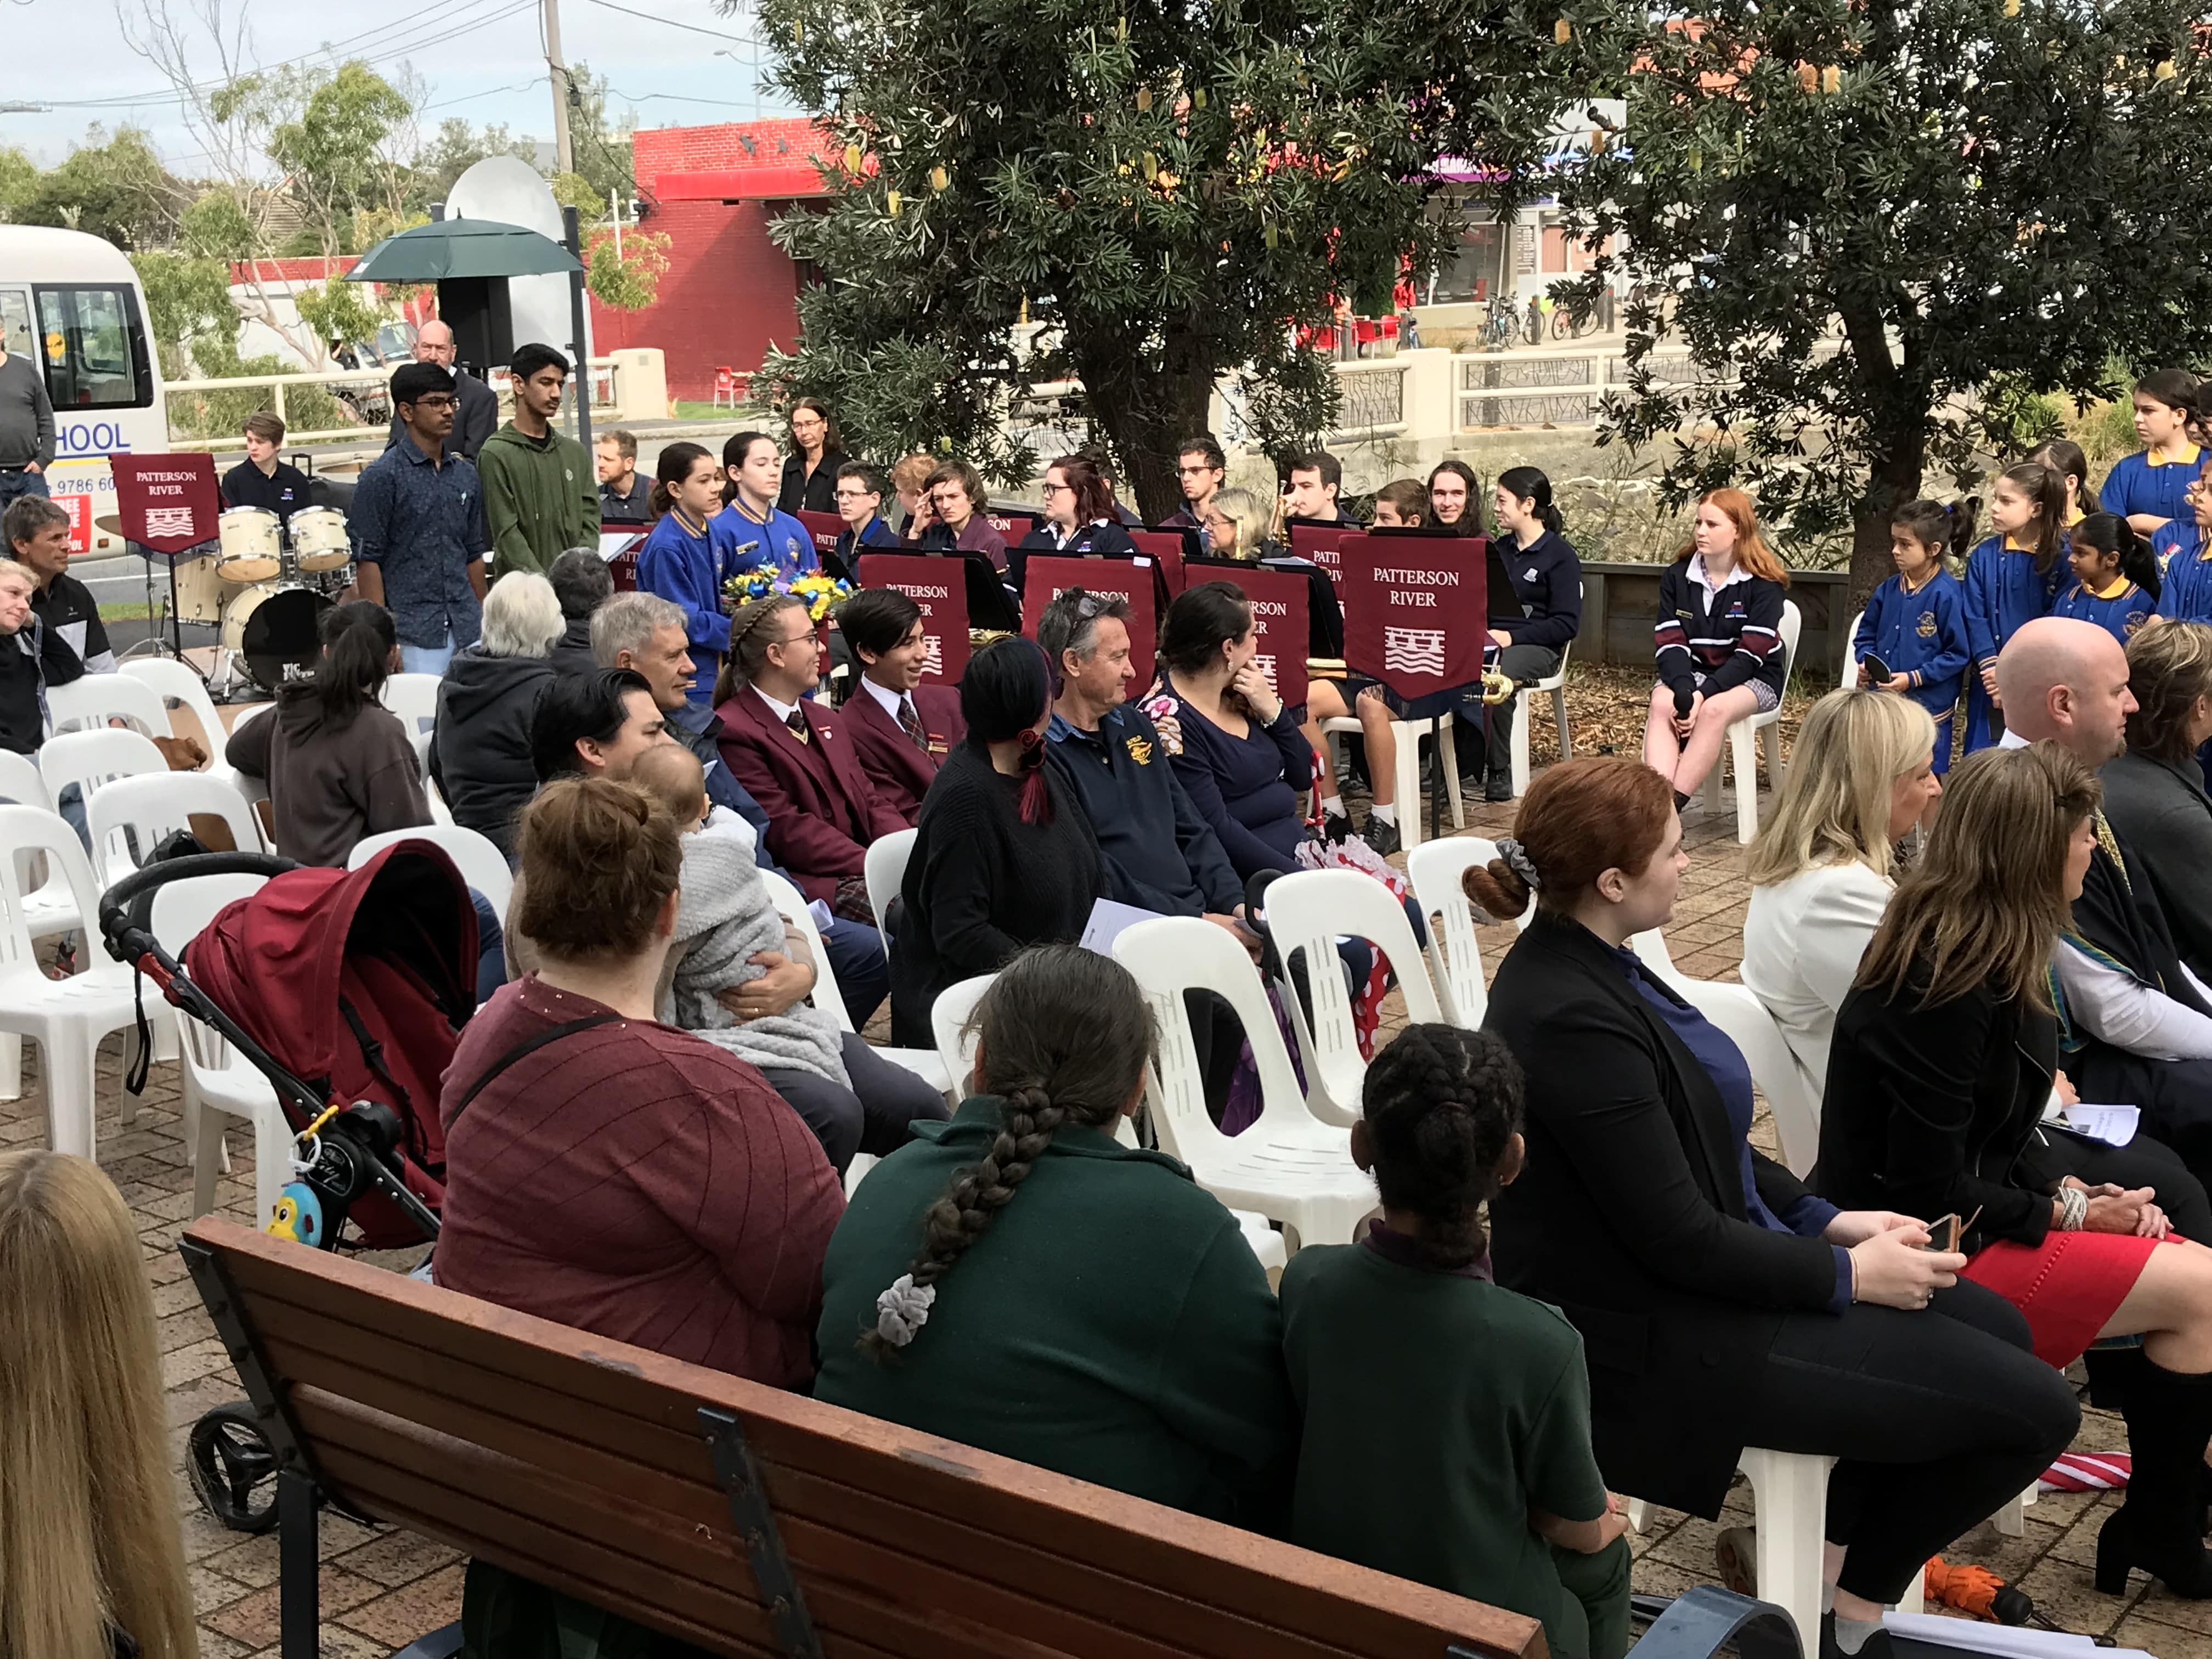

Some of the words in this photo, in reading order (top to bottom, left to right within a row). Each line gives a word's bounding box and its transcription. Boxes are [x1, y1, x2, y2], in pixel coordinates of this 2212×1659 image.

[136, 471, 197, 482] PATTERSON
[58, 478, 93, 494] 9786
[148, 485, 183, 495] RIVER
[1374, 567, 1459, 586] PATTERSON
[1390, 590, 1437, 607] RIVER
